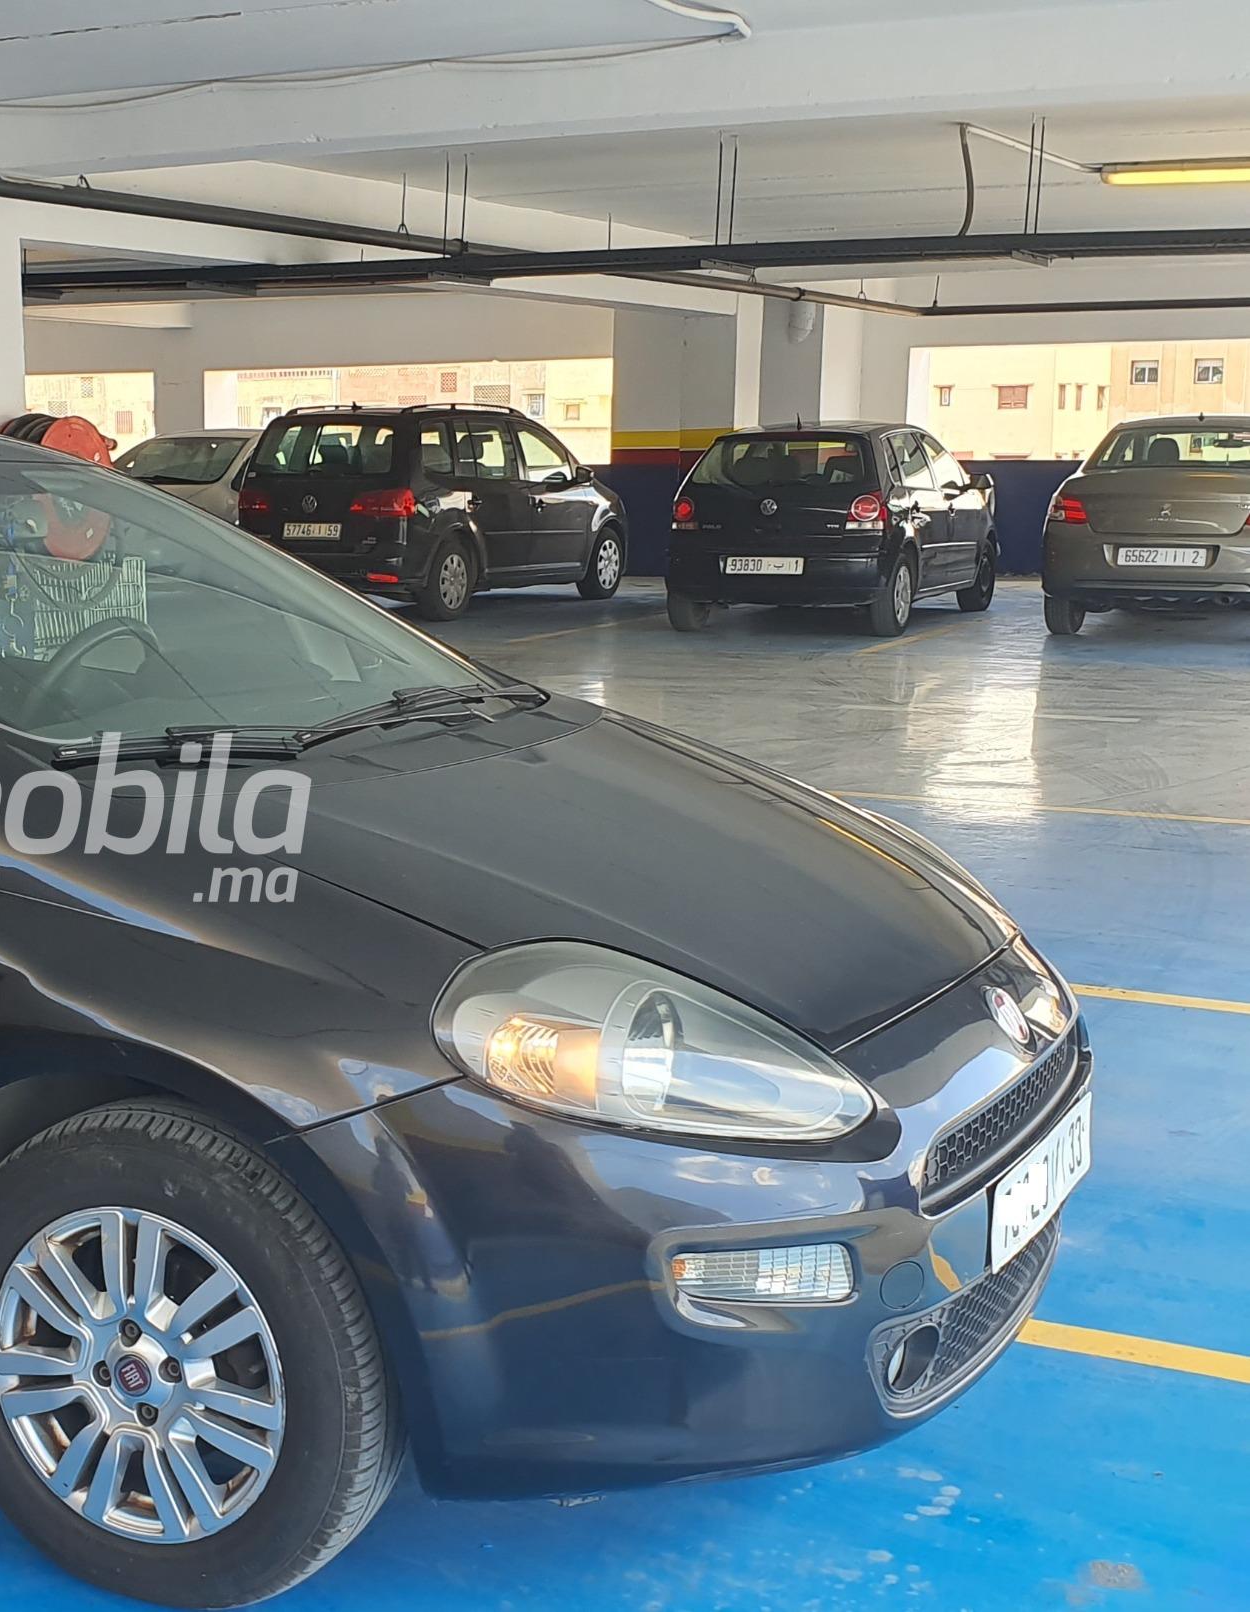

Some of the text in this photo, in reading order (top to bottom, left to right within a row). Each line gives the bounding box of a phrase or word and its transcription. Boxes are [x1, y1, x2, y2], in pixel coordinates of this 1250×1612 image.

[286, 524, 312, 536] 57746
[327, 524, 339, 536] 59
[1124, 549, 1159, 563] 65622
[1191, 550, 1200, 564] 2
[730, 558, 763, 572] 93830
[795, 559, 799, 573] 1
[1068, 1115, 1082, 1175] 33
[121, 1363, 144, 1388] FIAT
